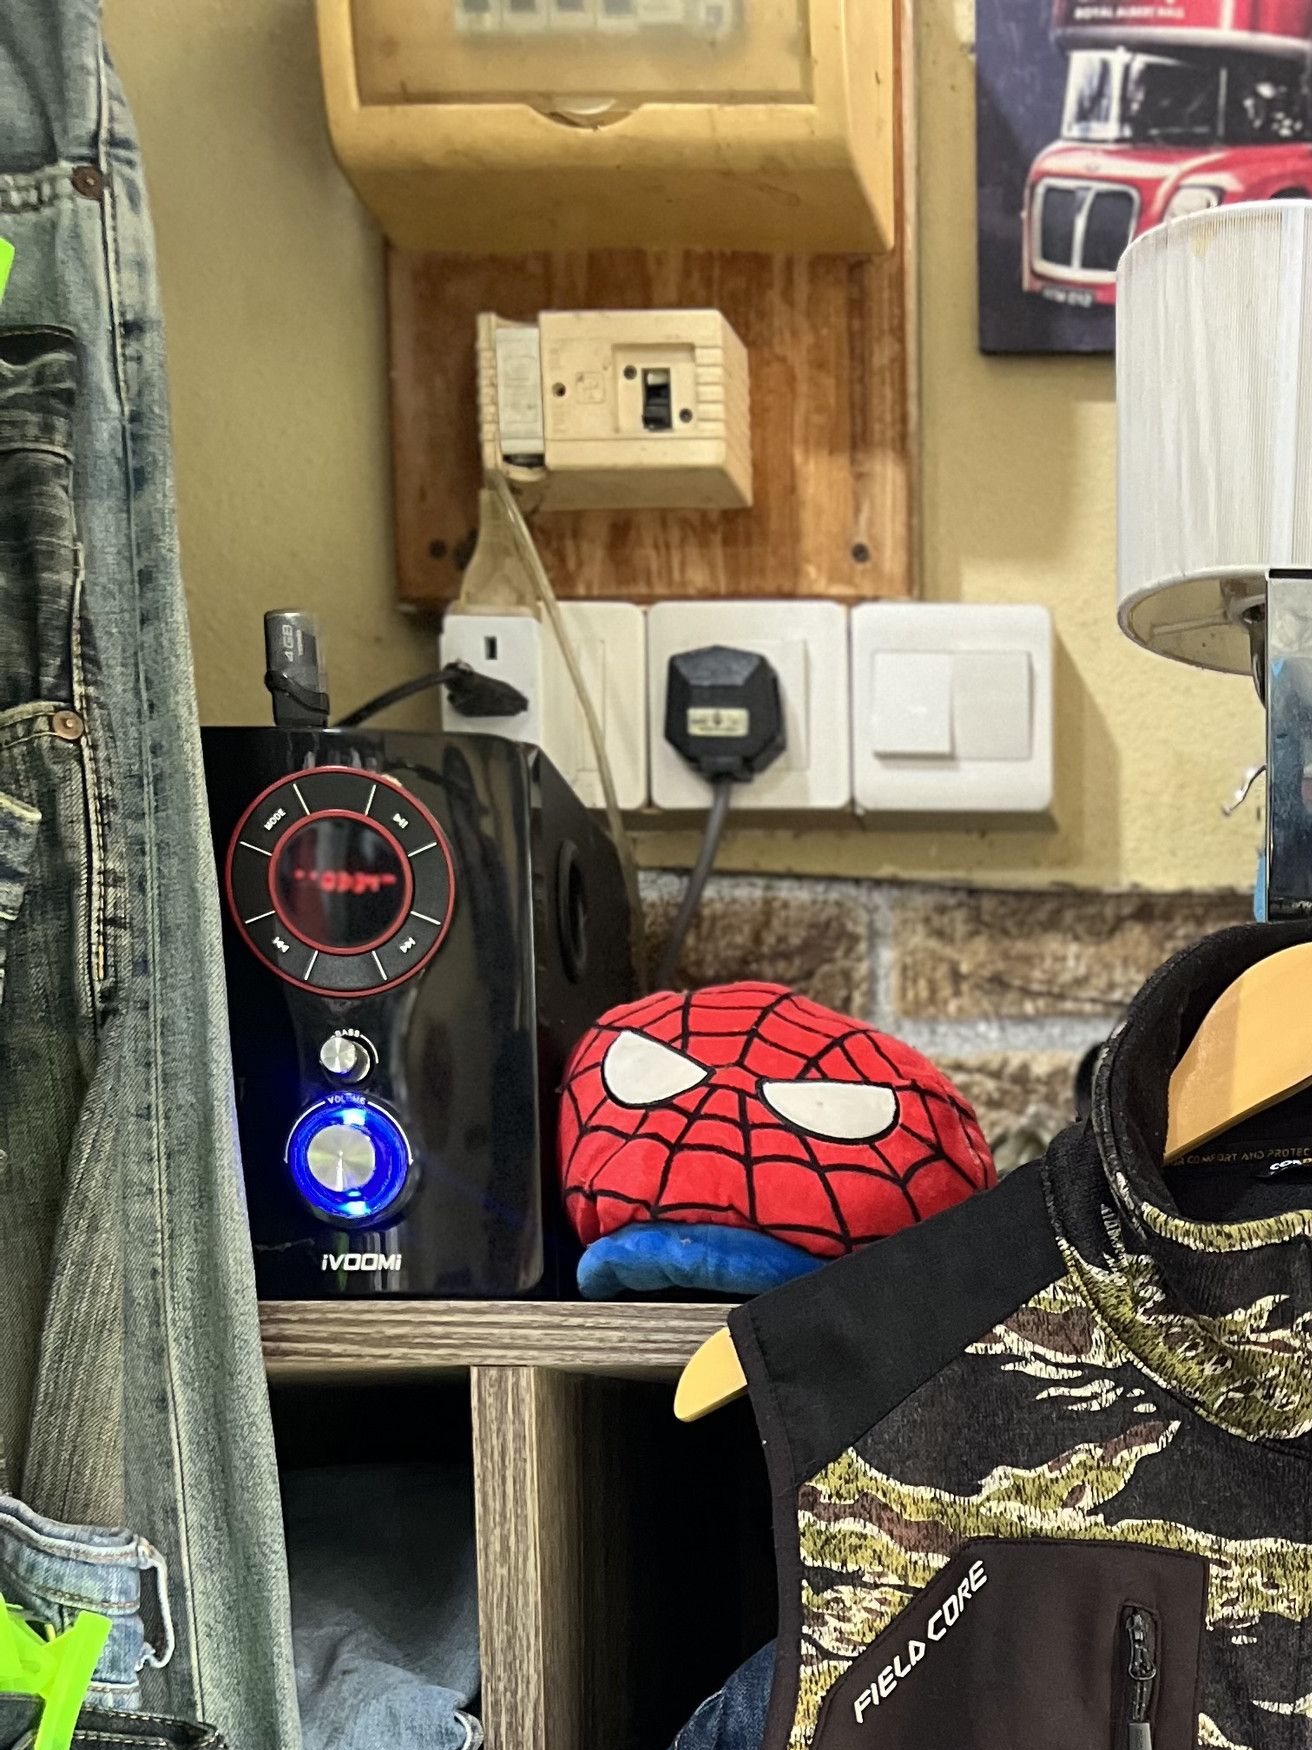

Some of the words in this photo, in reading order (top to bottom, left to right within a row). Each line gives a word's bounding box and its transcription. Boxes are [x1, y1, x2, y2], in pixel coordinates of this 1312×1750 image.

[281, 624, 294, 662] 4GB
[264, 808, 287, 831] MODE
[335, 1028, 361, 1039] BASS
[327, 1092, 367, 1105] VOLUME
[1186, 1153, 1238, 1165] COMFORT
[1241, 1151, 1266, 1161] AND
[854, 1640, 926, 1723] FIELD
[927, 1560, 988, 1641] CORE
